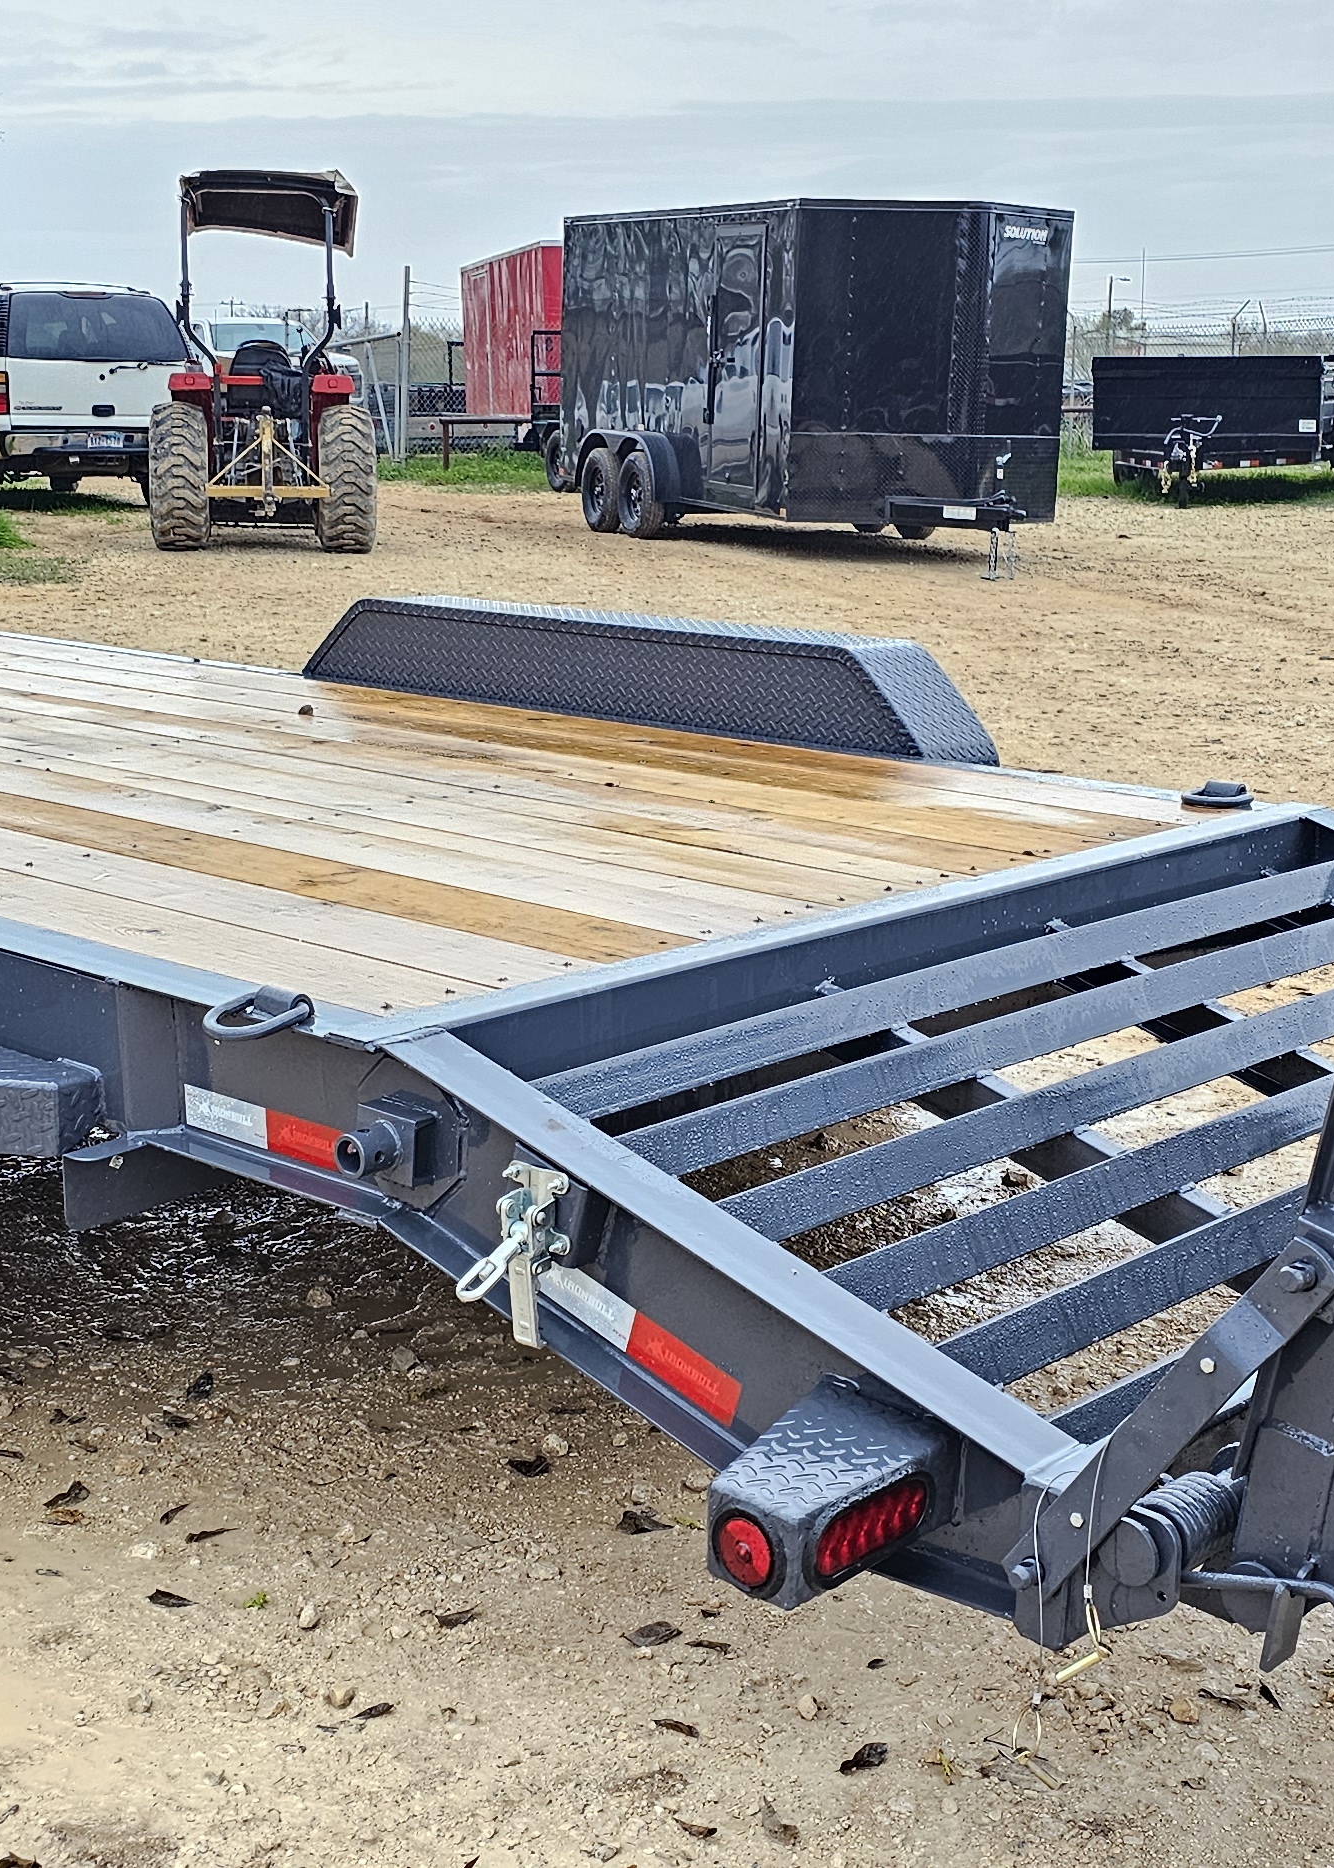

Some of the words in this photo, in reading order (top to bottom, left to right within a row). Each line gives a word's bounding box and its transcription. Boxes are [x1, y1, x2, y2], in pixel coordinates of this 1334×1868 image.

[1004, 225, 1048, 242] SOLUTION
[210, 1104, 254, 1127] IRONBULL
[564, 1276, 615, 1322] IRONBULL
[664, 1350, 719, 1396] IRONBULL
